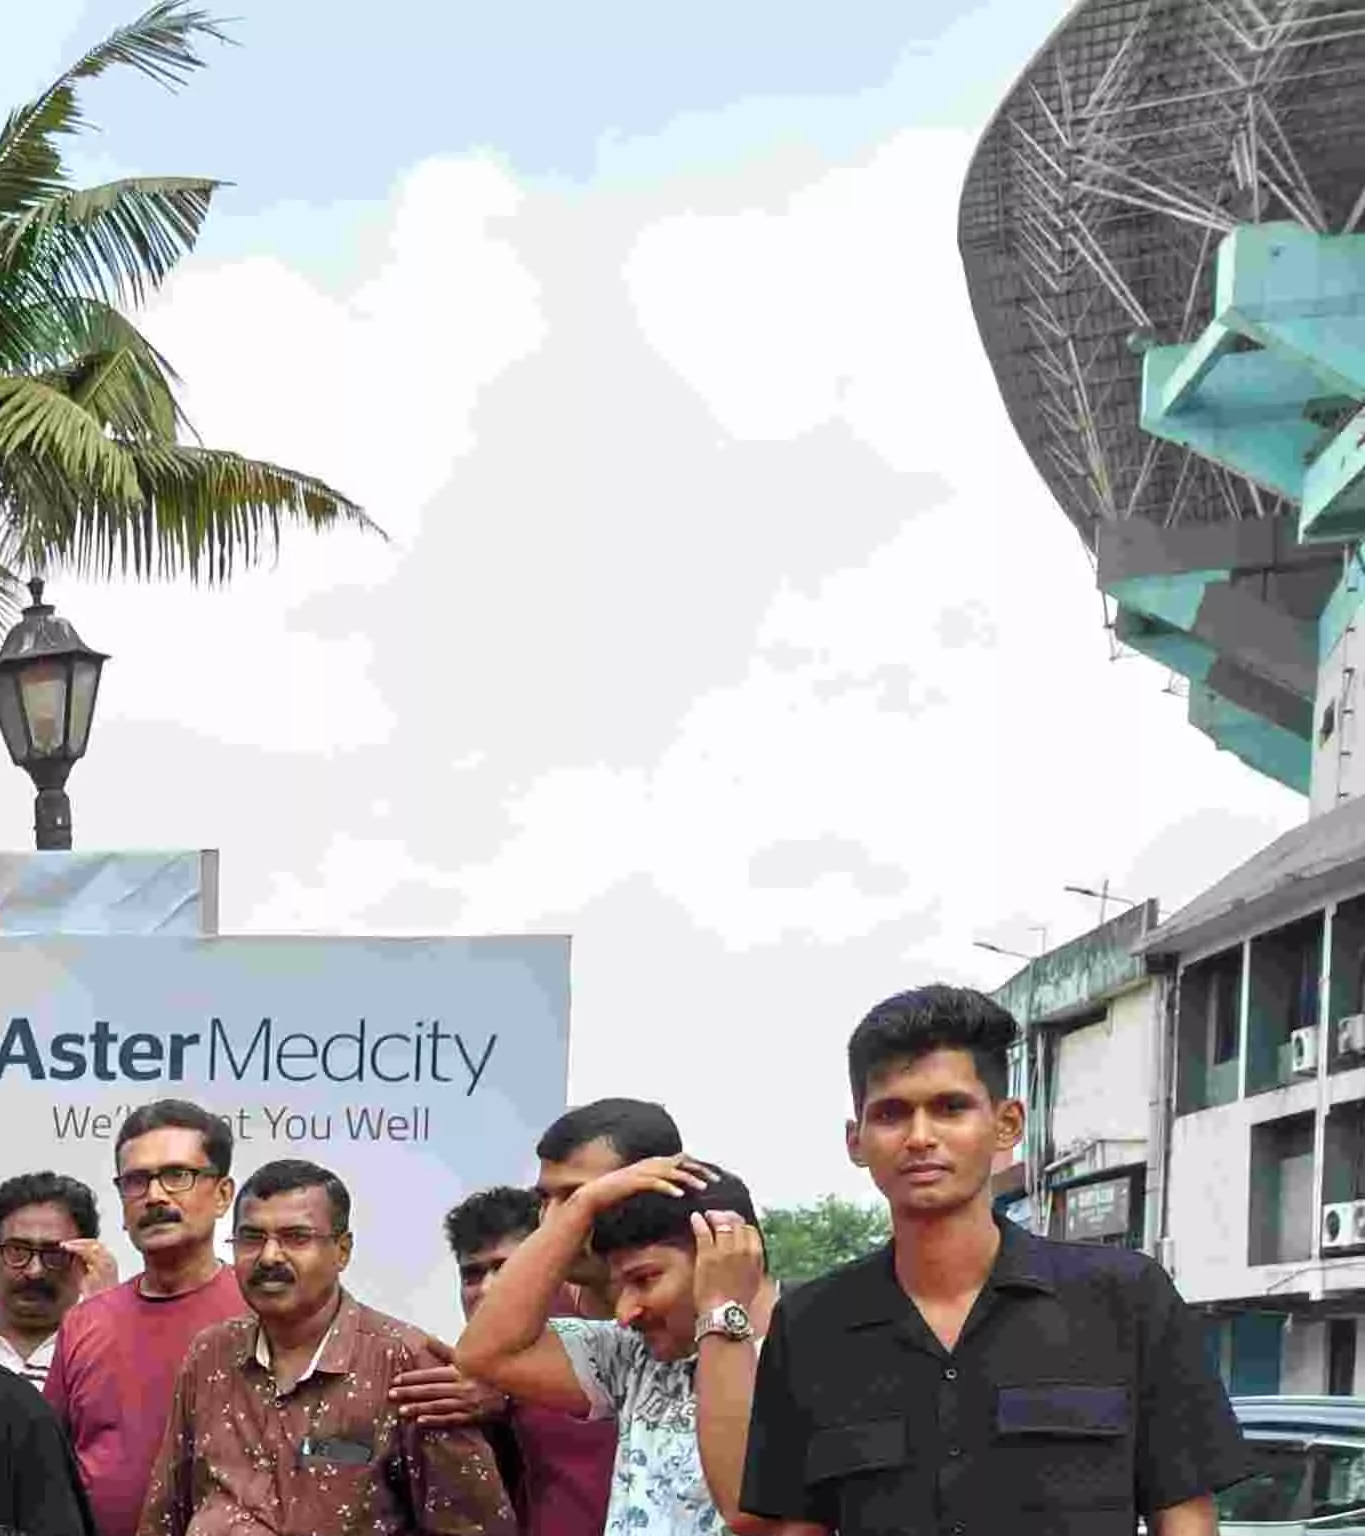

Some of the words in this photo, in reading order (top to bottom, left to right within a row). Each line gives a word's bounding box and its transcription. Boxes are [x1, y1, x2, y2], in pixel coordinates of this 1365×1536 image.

[209, 1018, 497, 1096] Medcity
[263, 1106, 332, 1140] You
[345, 1106, 430, 1141] Well
